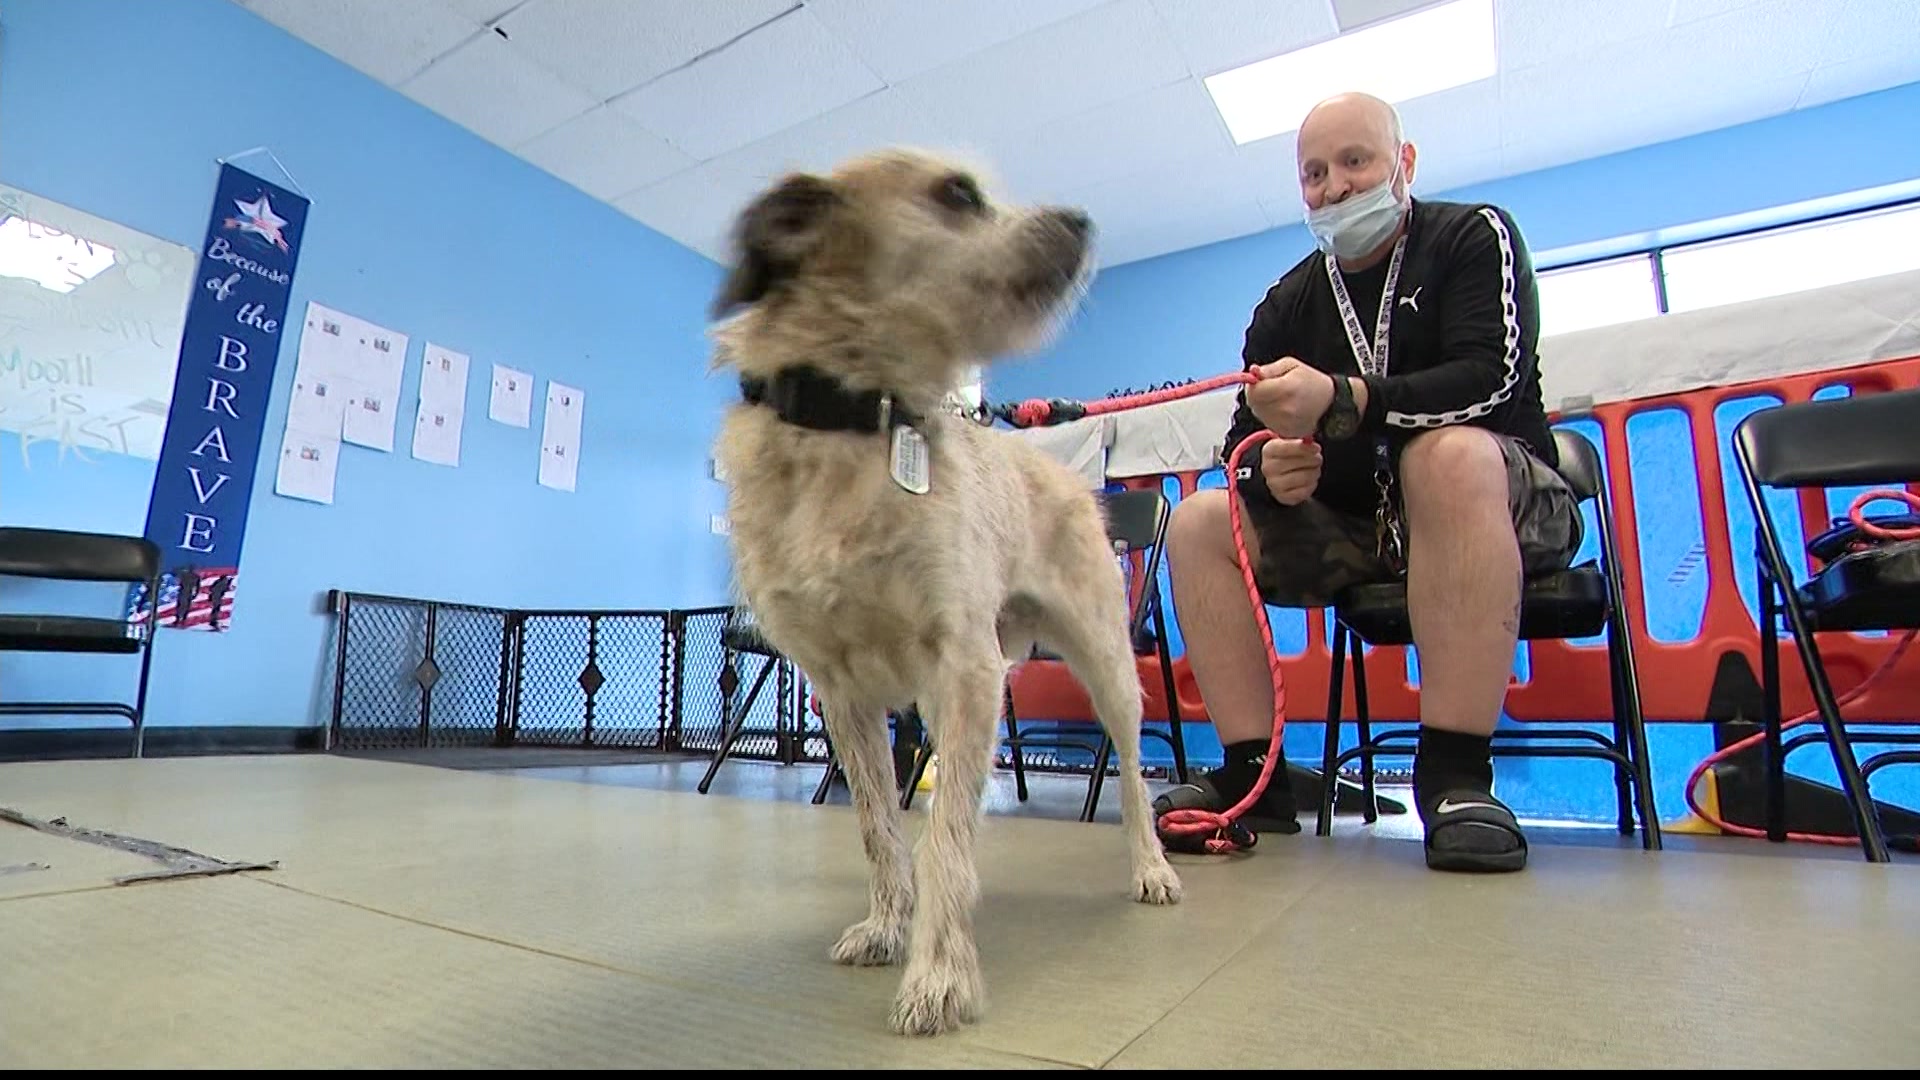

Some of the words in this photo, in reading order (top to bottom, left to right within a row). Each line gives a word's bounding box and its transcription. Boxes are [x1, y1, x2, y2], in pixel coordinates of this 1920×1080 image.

[207, 237, 290, 285] Because
[206, 272, 242, 301] of
[236, 302, 279, 334] the
[176, 335, 248, 553] BRAVE
